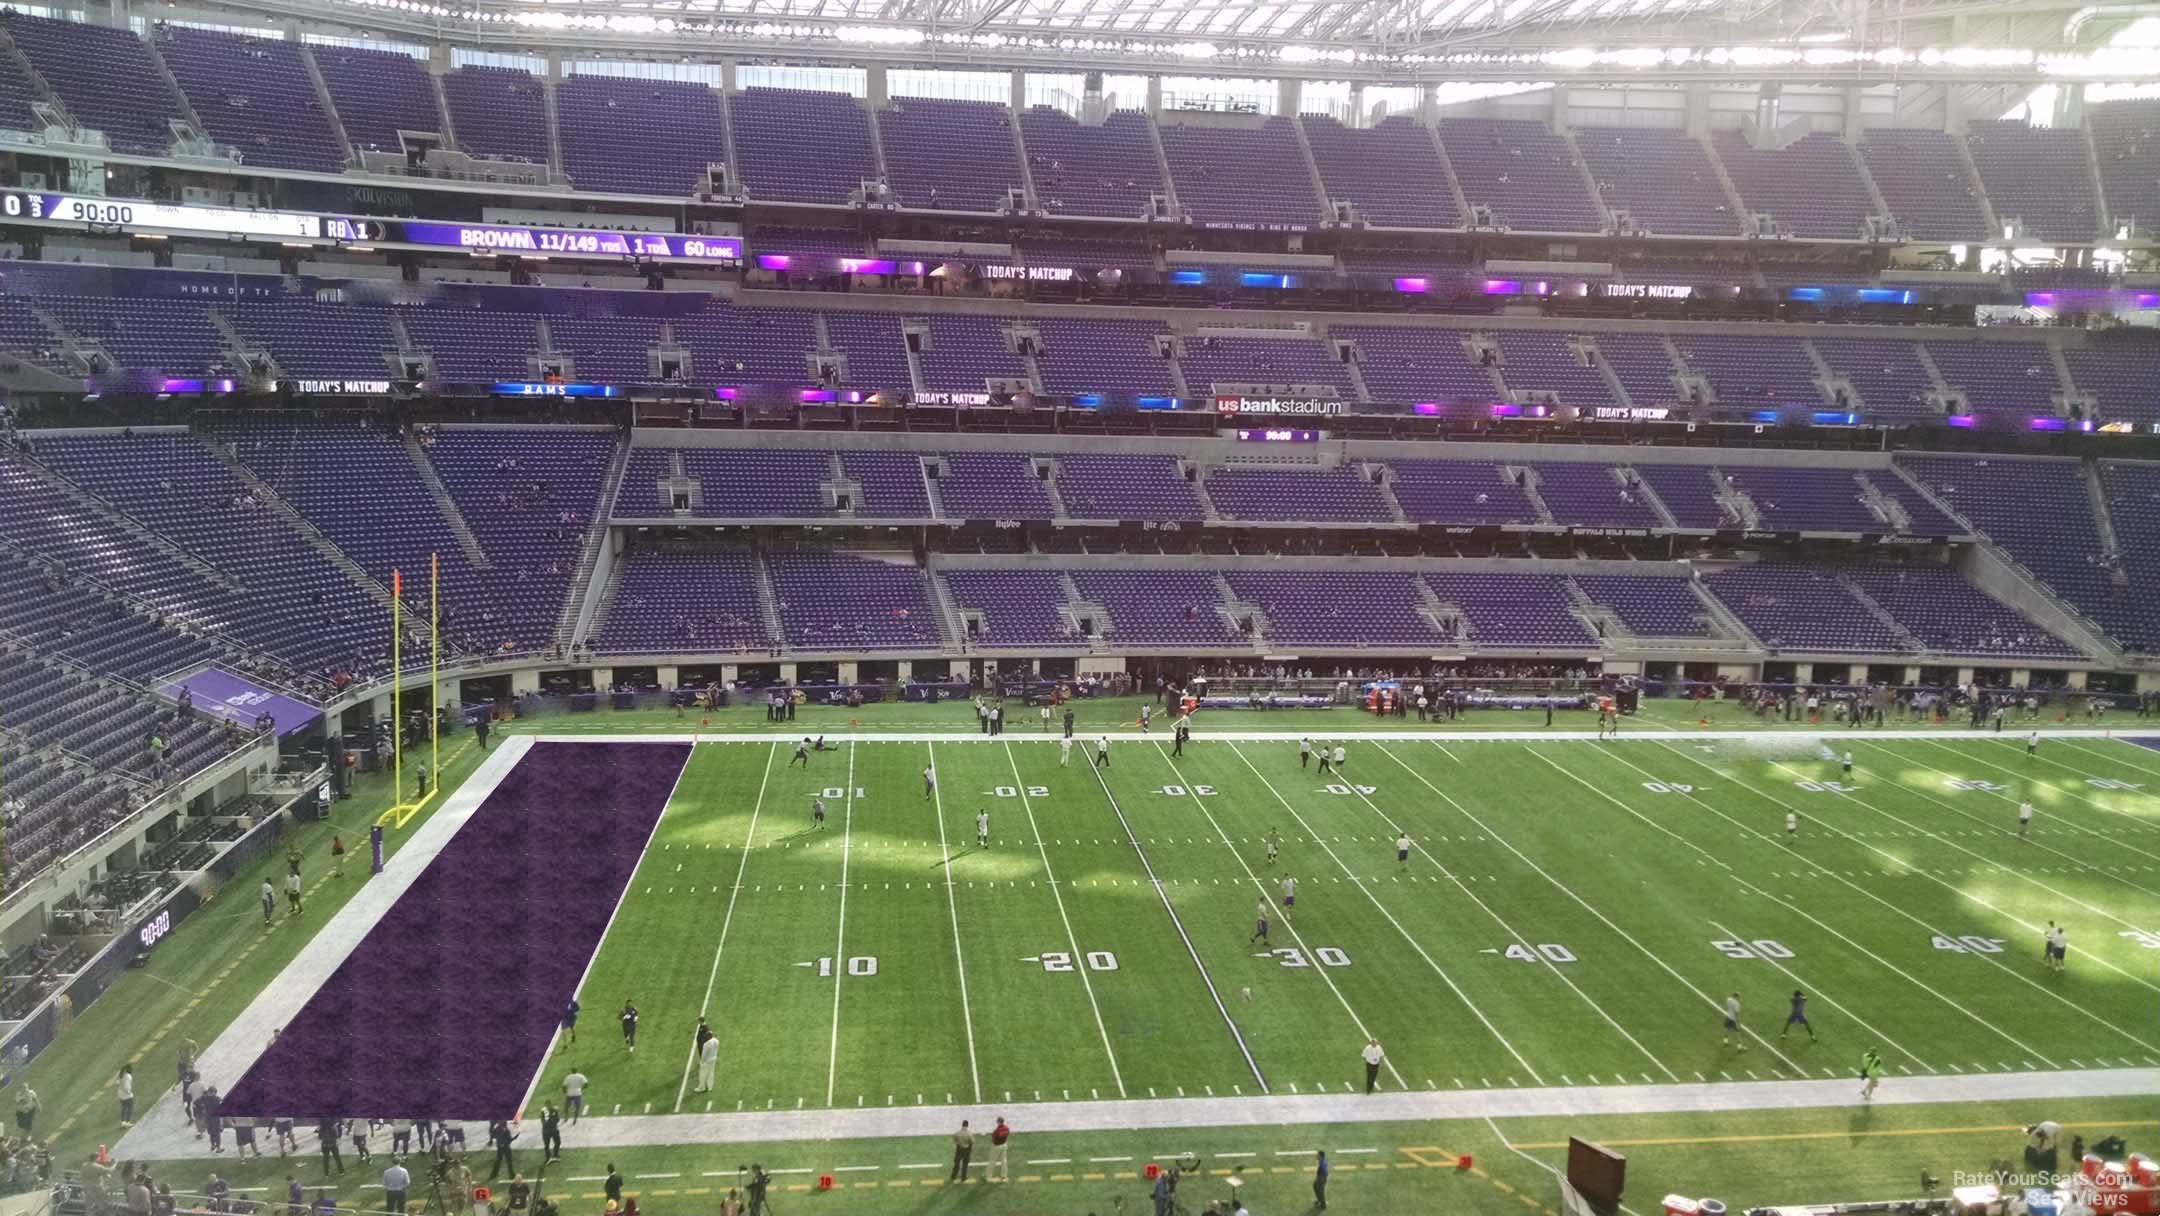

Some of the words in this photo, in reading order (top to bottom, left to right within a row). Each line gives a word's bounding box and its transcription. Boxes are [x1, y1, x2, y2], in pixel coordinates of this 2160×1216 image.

[5, 195, 20, 216] 0
[31, 203, 41, 218] 3
[73, 202, 133, 223] 90:00
[327, 220, 346, 238] RB
[357, 223, 368, 239] 1
[461, 229, 529, 249] BROWN
[540, 233, 598, 252] 11/149
[634, 238, 645, 253] 1
[684, 241, 705, 256] 60
[705, 246, 733, 258] LONG
[987, 265, 1026, 279] TODAY'S
[1029, 266, 1072, 280] MATCHUP
[181, 285, 218, 294] HOME
[228, 287, 245, 296] OF
[1608, 284, 1645, 297] TODAY'S
[1649, 285, 1691, 298] MATCHUP
[298, 380, 340, 393] TODAY'S
[344, 381, 390, 393] MATCHUP
[523, 384, 566, 395] RAMS
[915, 392, 949, 404] TODAY'S
[952, 393, 990, 405] MATCHUP
[1597, 407, 1629, 418] TODAY'S
[1631, 408, 1668, 419] MATCHUP
[141, 910, 170, 946] 90:00
[1271, 947, 1352, 968] 30
[1504, 943, 1579, 964] 40
[1710, 939, 1796, 959] 50
[817, 956, 879, 977] 10
[1040, 951, 1120, 972] 20
